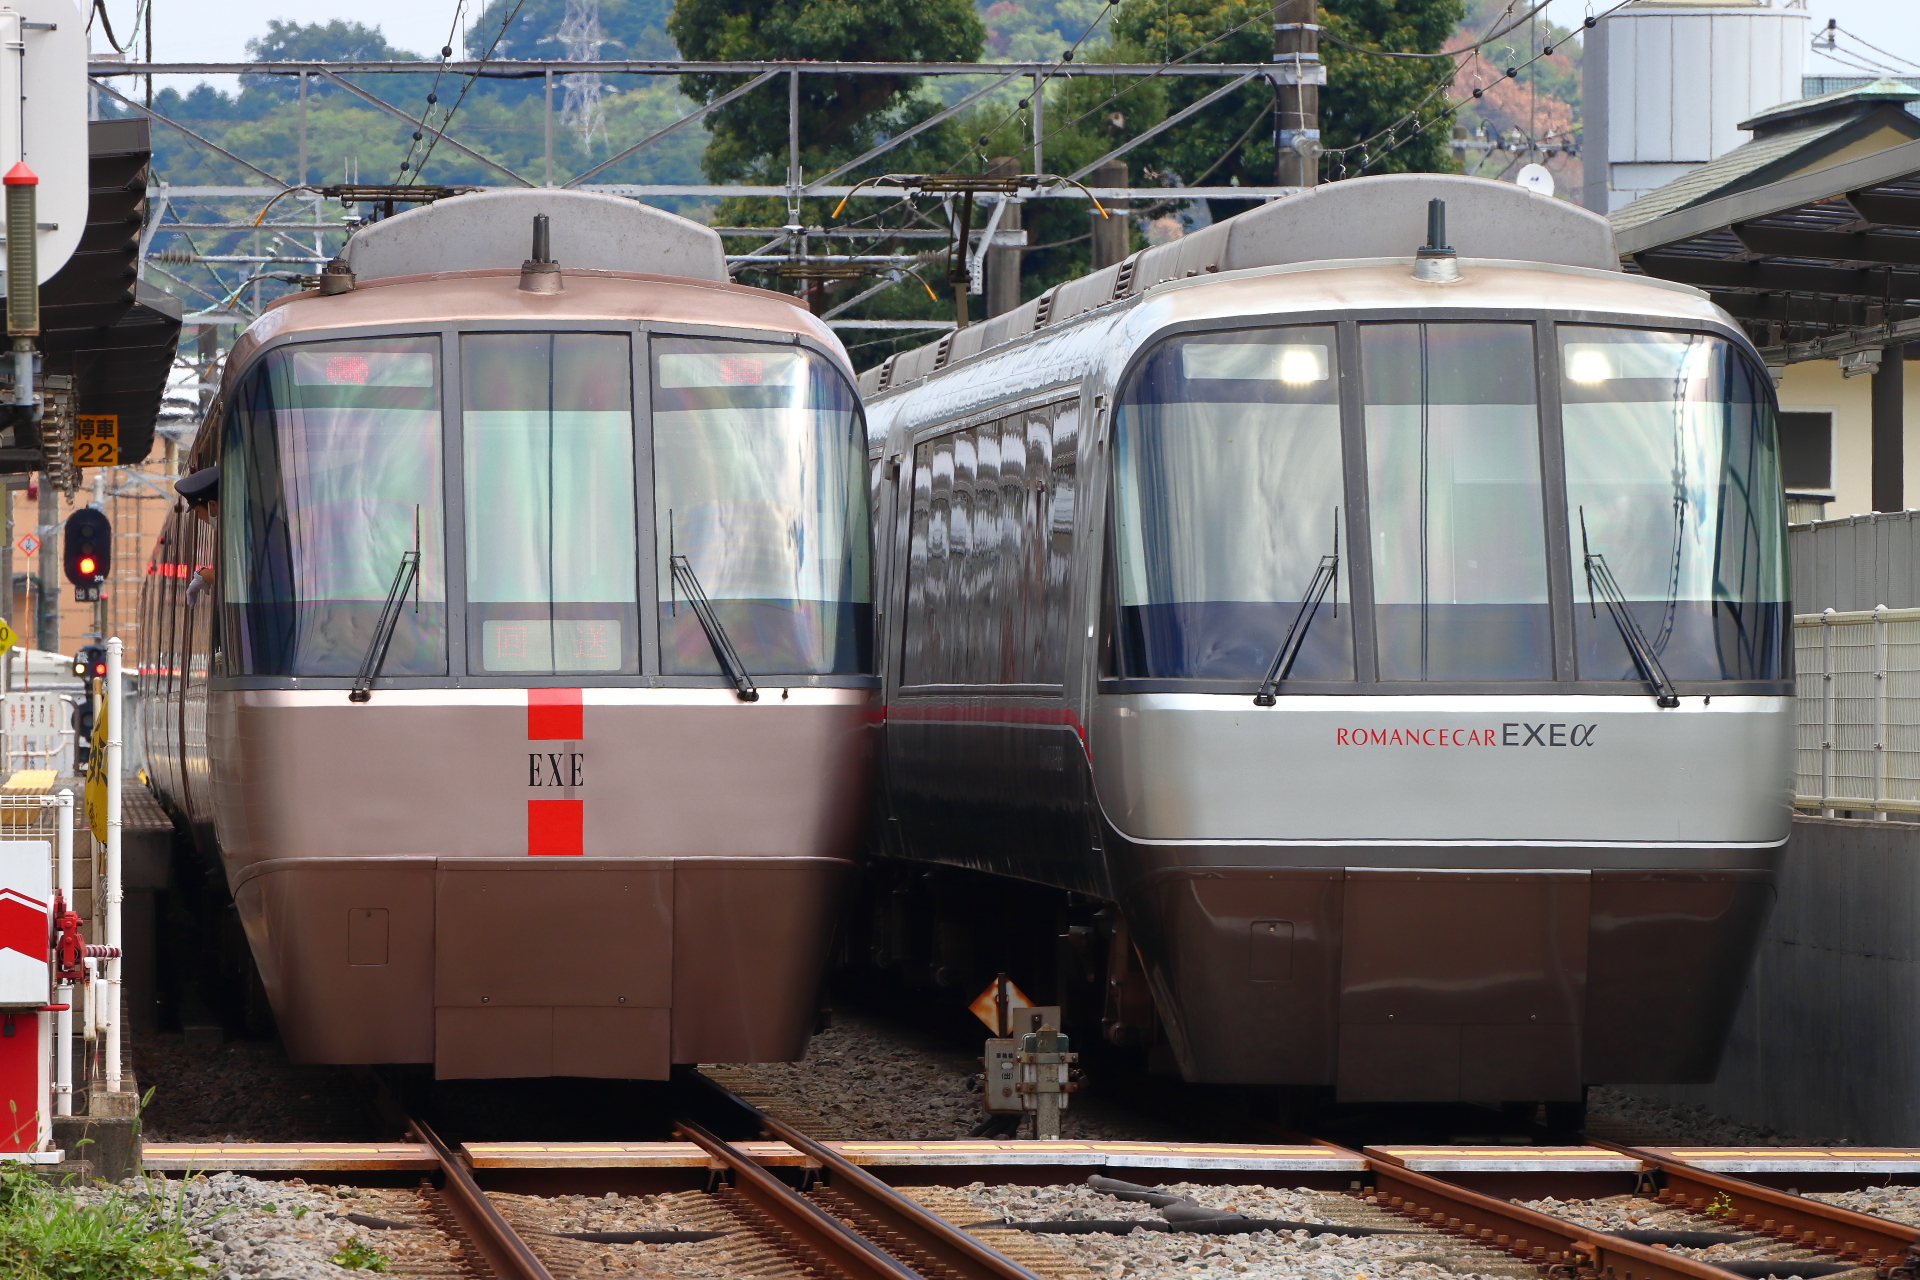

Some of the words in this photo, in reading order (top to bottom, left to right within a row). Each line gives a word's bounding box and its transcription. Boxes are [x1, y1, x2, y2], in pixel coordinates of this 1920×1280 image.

[76, 418, 115, 441] 停車
[77, 442, 114, 462] 22
[496, 624, 608, 659] 回送
[1336, 727, 1496, 747] ROMANCECAR
[1502, 723, 1598, 747] EXEα
[527, 753, 584, 787] EXE
